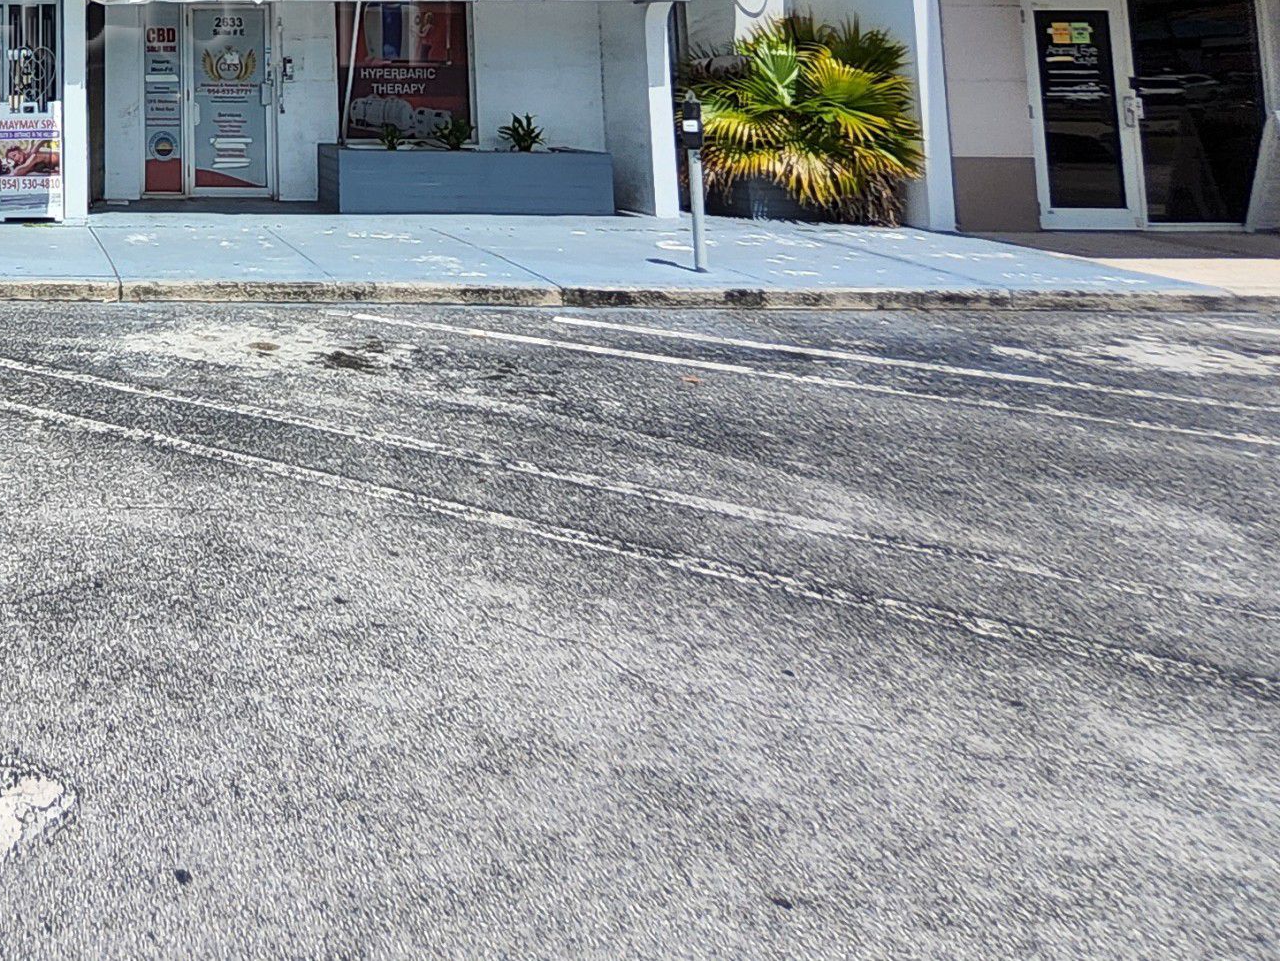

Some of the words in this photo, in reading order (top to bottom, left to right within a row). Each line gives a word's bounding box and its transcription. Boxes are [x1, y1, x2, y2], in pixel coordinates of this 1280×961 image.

[214, 17, 243, 28] 2633
[147, 28, 176, 43] CBD
[360, 68, 436, 79] HYPERBARIC
[371, 83, 426, 94] THERAPY
[41, 120, 57, 129] SPA
[0, 179, 20, 191] (954)
[22, 179, 60, 190] 530-4810
